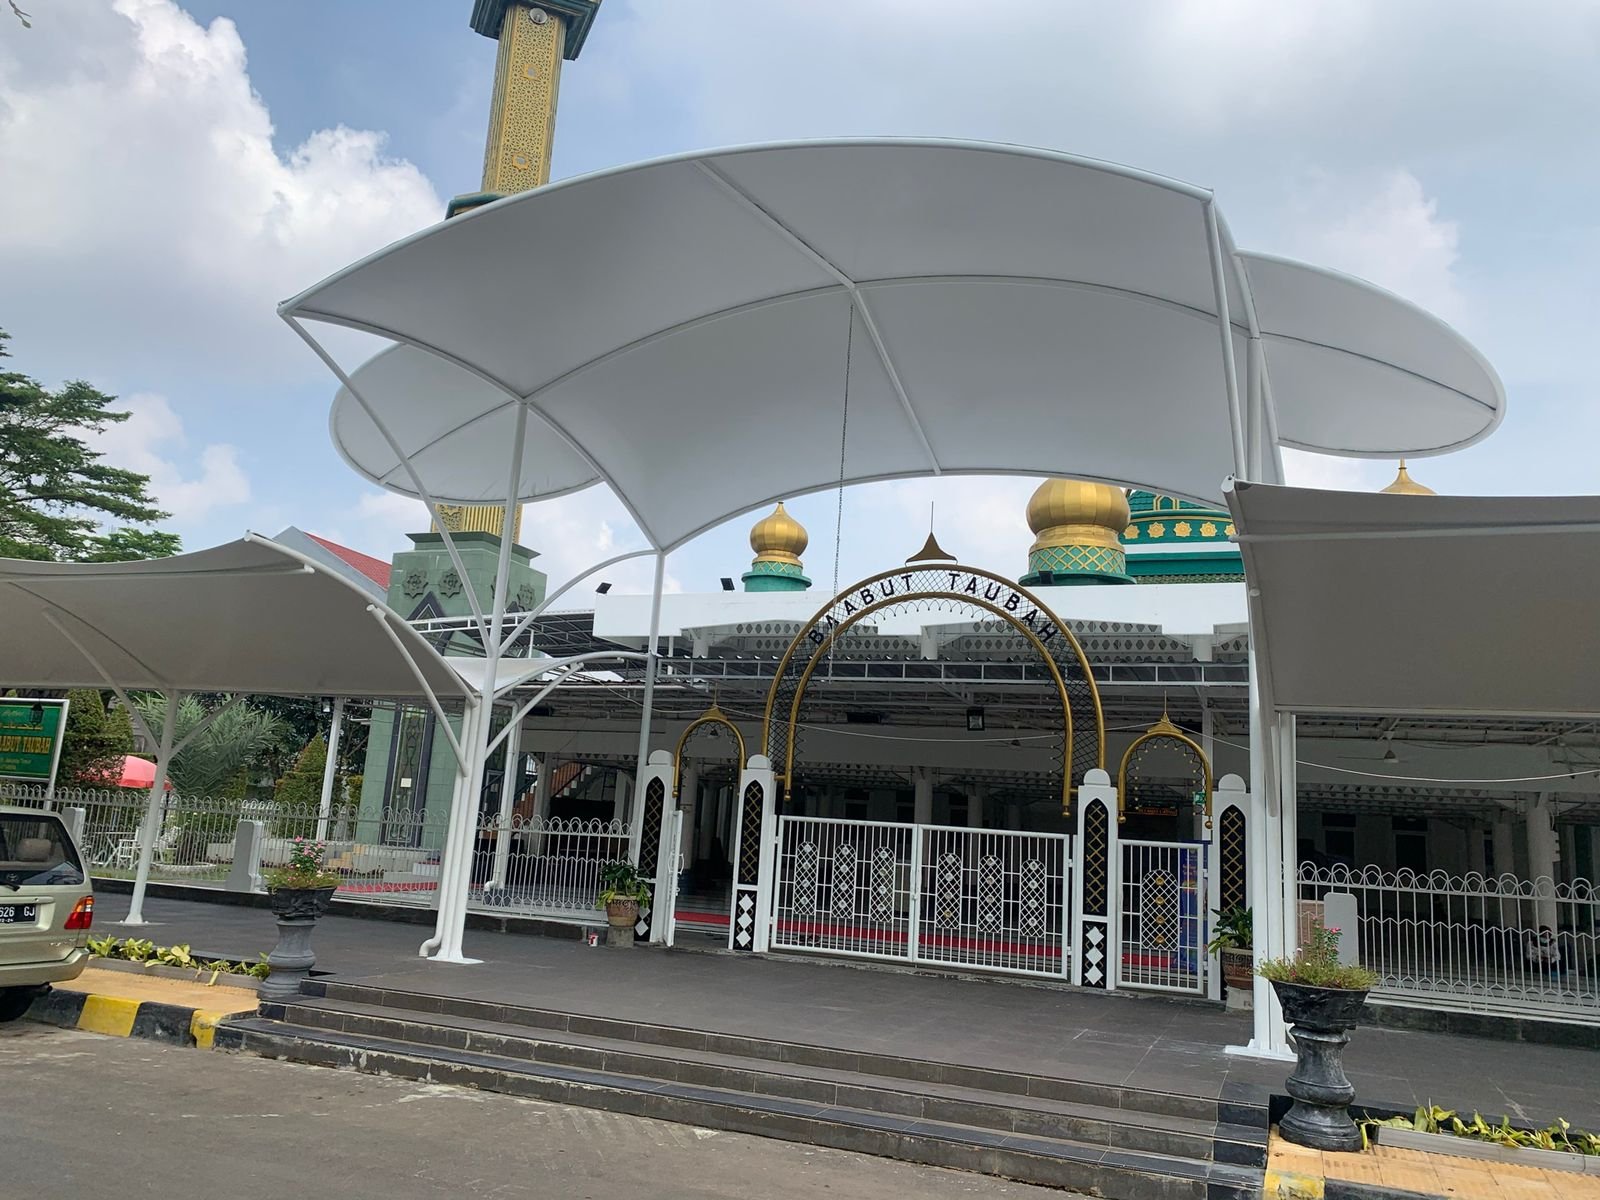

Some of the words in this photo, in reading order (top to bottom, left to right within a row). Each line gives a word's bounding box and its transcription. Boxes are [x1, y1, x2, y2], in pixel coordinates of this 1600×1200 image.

[808, 574, 913, 646] BAABUT
[948, 572, 1058, 643] TAUBAH
[23, 906, 35, 917] GJ
